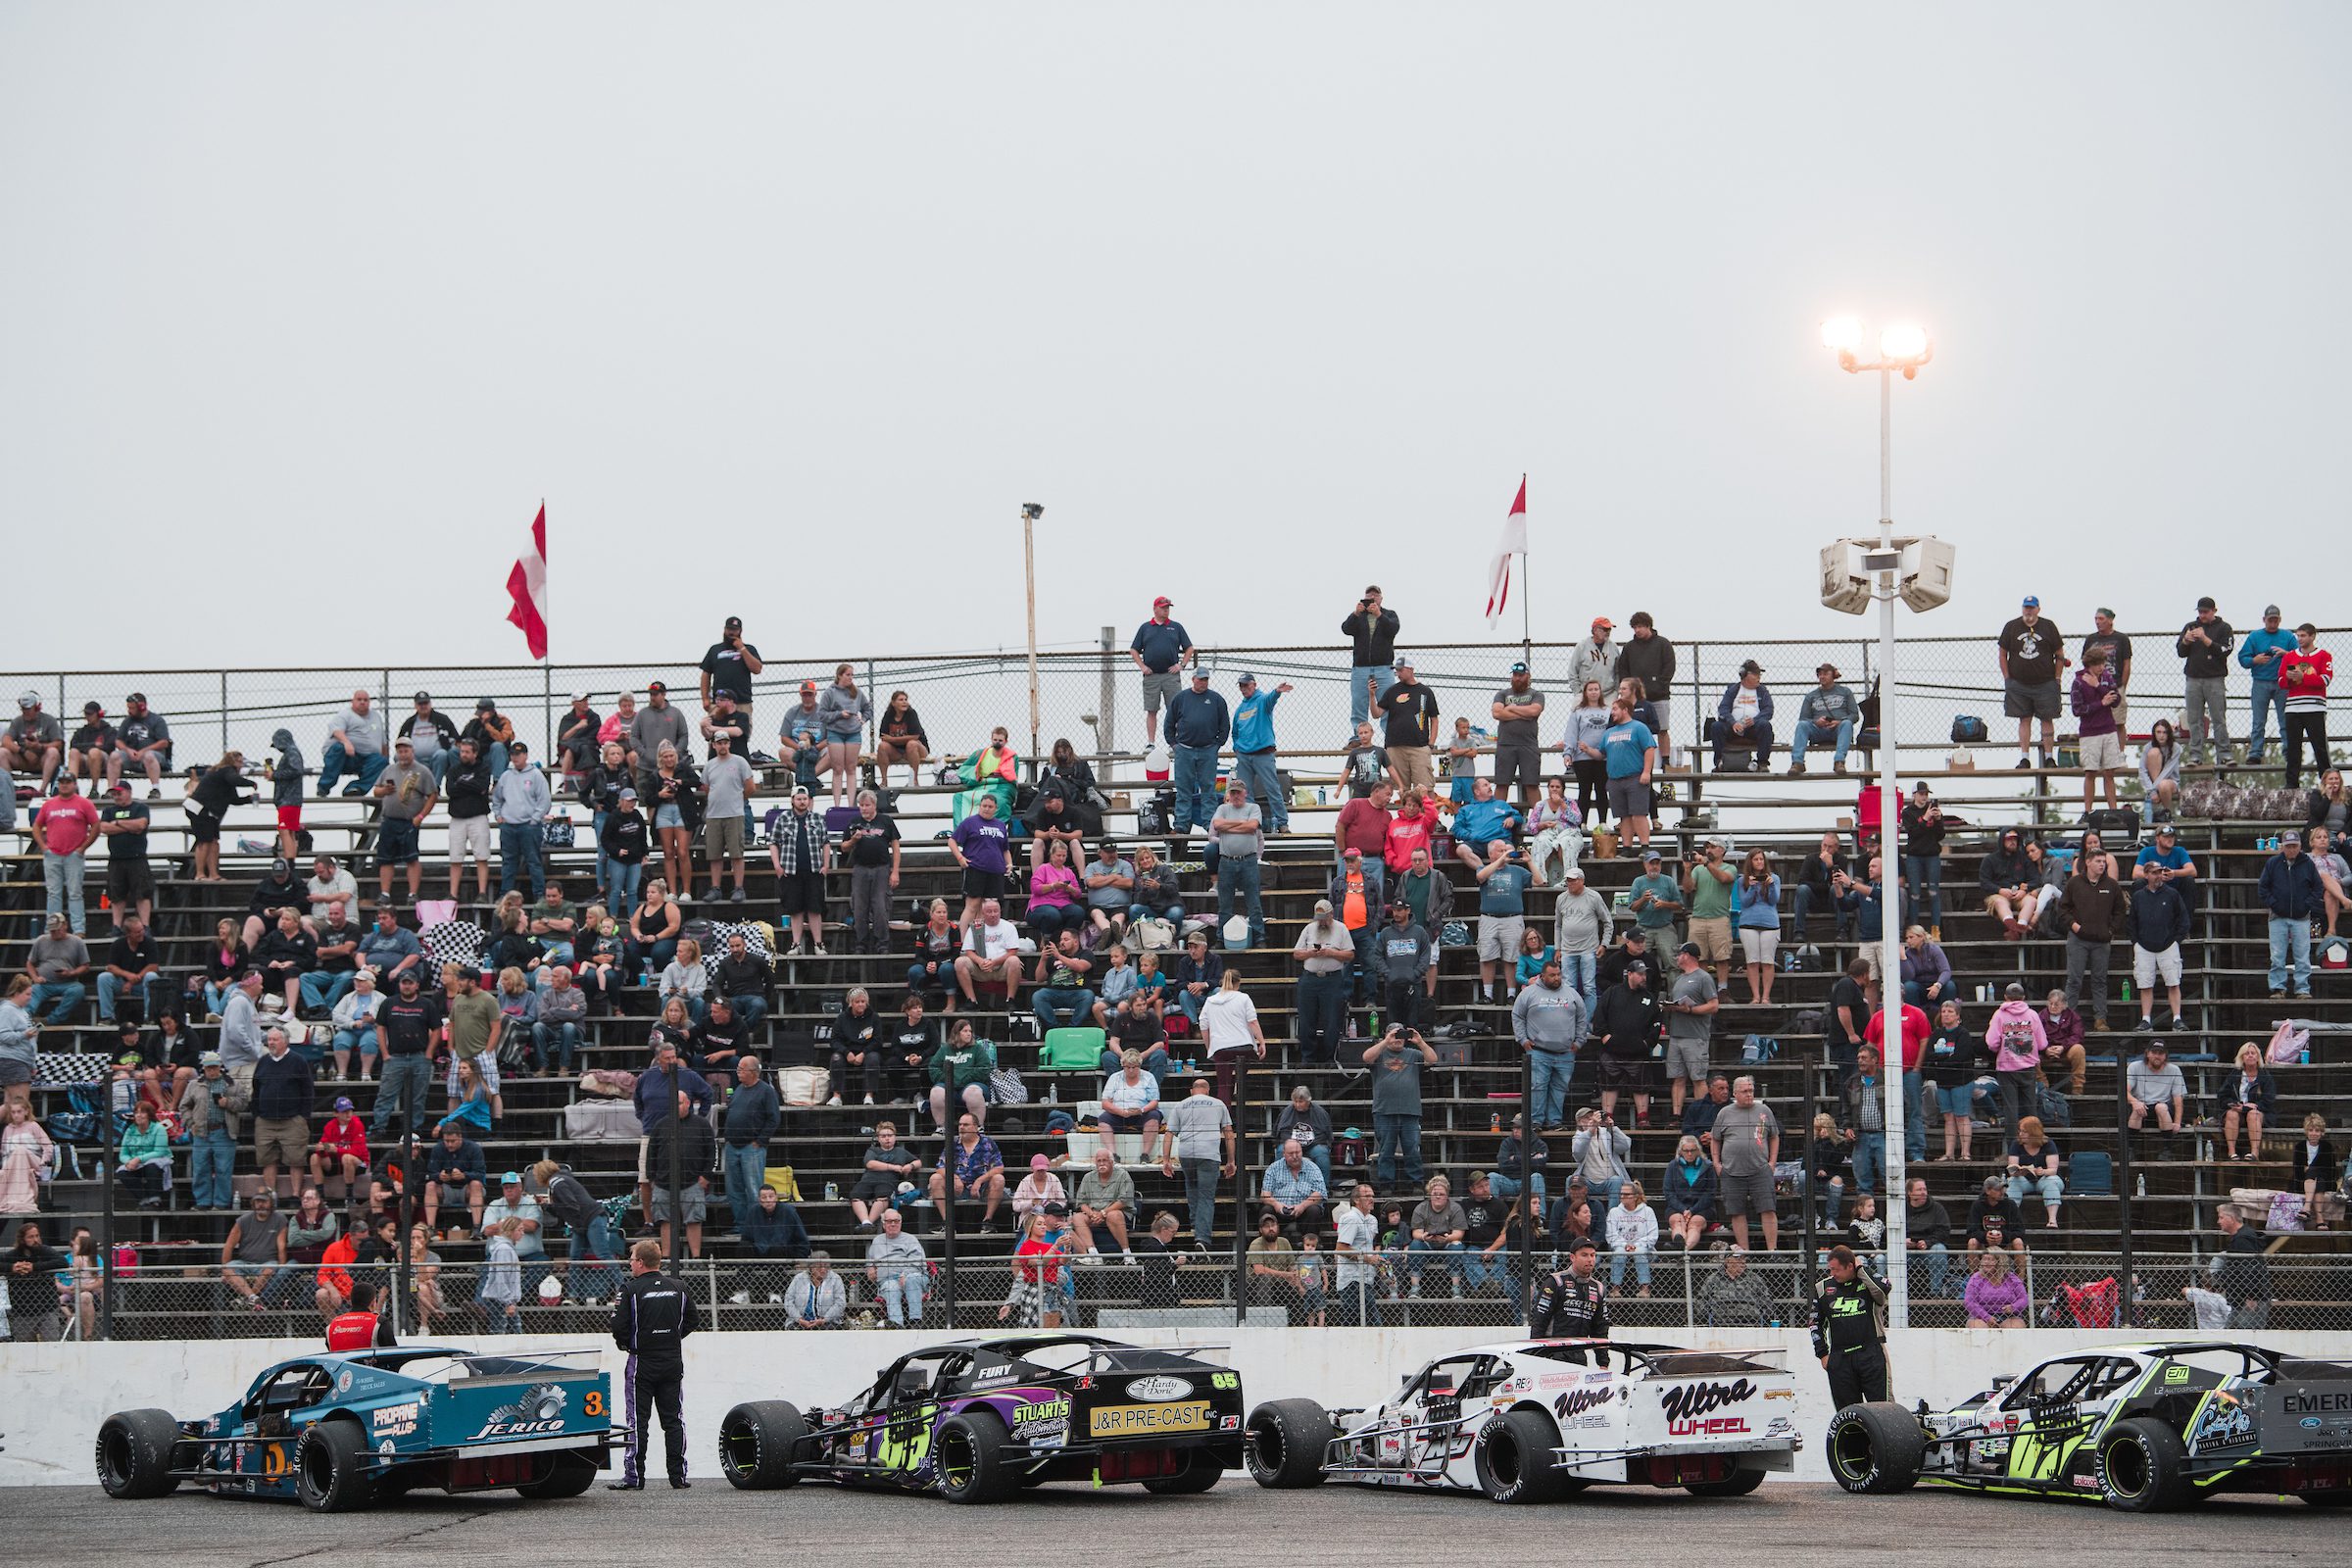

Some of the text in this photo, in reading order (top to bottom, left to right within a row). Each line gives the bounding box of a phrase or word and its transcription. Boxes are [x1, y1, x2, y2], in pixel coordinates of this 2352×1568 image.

[978, 1363, 1013, 1379] FURY
[1211, 1372, 1240, 1390] 85
[1661, 1378, 1757, 1422] Ultra
[2164, 1385, 2204, 1394] AUTOSPORT
[373, 1402, 418, 1427] PROPANE
[584, 1391, 604, 1416] 3
[1554, 1386, 1615, 1420] Ultra
[2283, 1394, 2352, 1412] EMER
[1094, 1406, 1218, 1430] J&R PRE-CAST INC
[1559, 1414, 1611, 1431] WHEEL
[1668, 1417, 1752, 1436] WHEEL
[1829, 1411, 1857, 1439] Hoosier
[466, 1420, 565, 1441] JERICO
[1477, 1417, 1505, 1447] Hoosier
[2095, 1451, 2117, 1501] Hoosier
